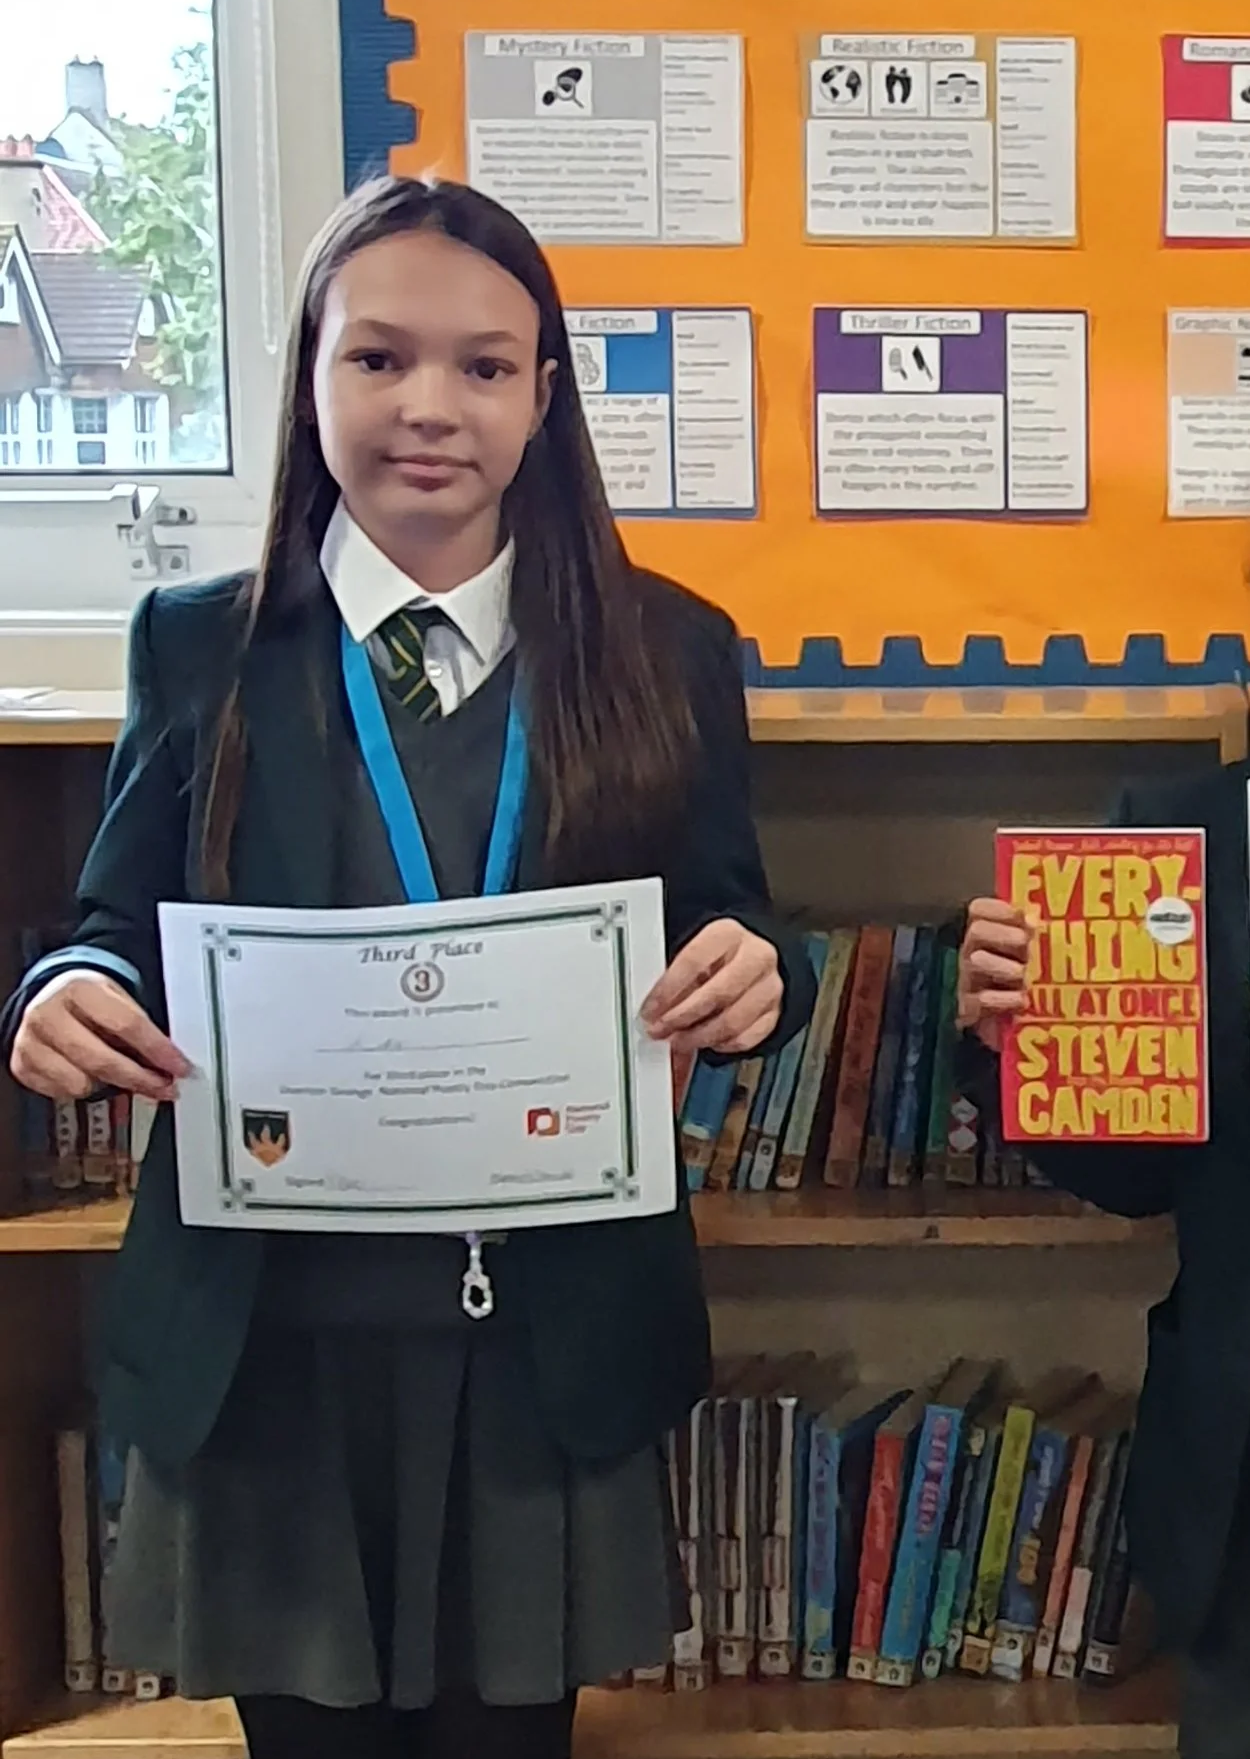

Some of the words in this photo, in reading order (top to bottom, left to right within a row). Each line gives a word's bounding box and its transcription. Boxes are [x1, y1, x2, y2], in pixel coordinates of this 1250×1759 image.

[356, 942, 417, 963] Third
[430, 939, 483, 961] Place
[414, 969, 430, 993] 3
[1076, 987, 1111, 1018] AT
[1119, 986, 1196, 1018] ONCE
[1016, 1024, 1198, 1080] STEVEN
[1018, 1080, 1199, 1136] CAMDEN
